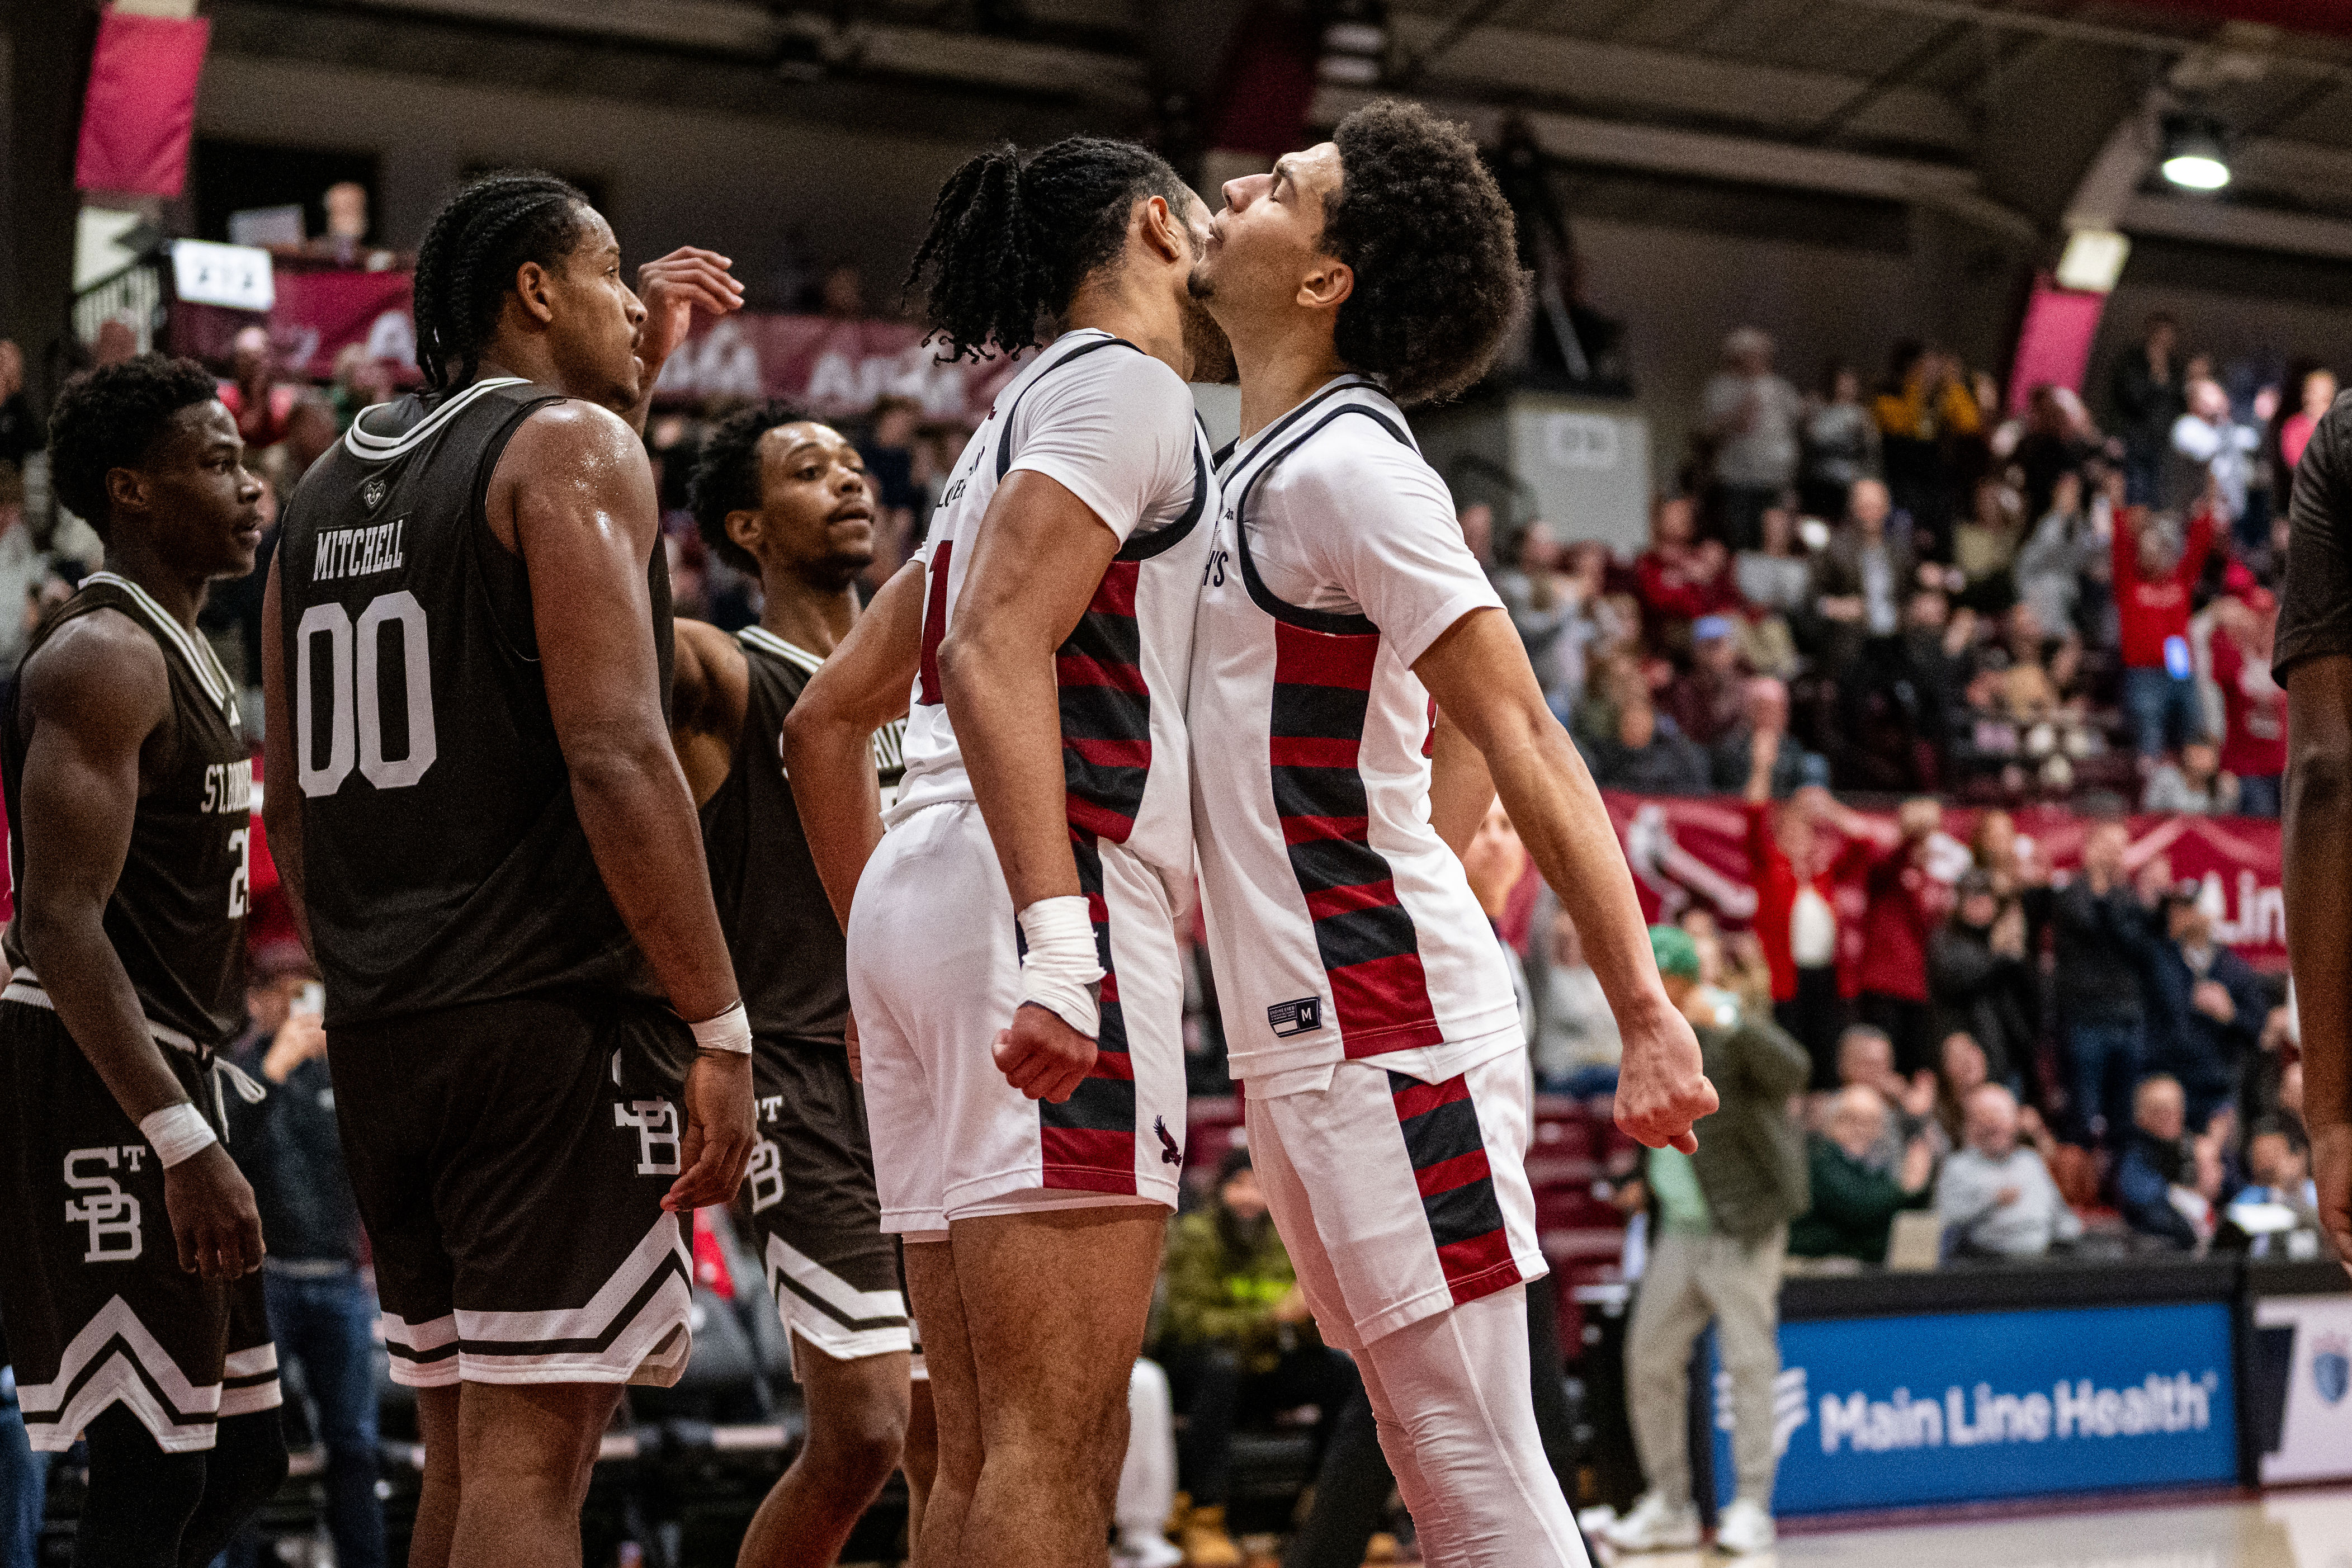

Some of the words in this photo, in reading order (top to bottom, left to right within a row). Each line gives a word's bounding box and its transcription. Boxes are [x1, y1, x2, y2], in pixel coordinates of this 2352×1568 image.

[313, 519, 403, 582] MITCHELL
[297, 590, 437, 799] 00
[1301, 1007, 1312, 1022] M
[1819, 1387, 1943, 1454] Main
[1945, 1381, 2051, 1447] Line
